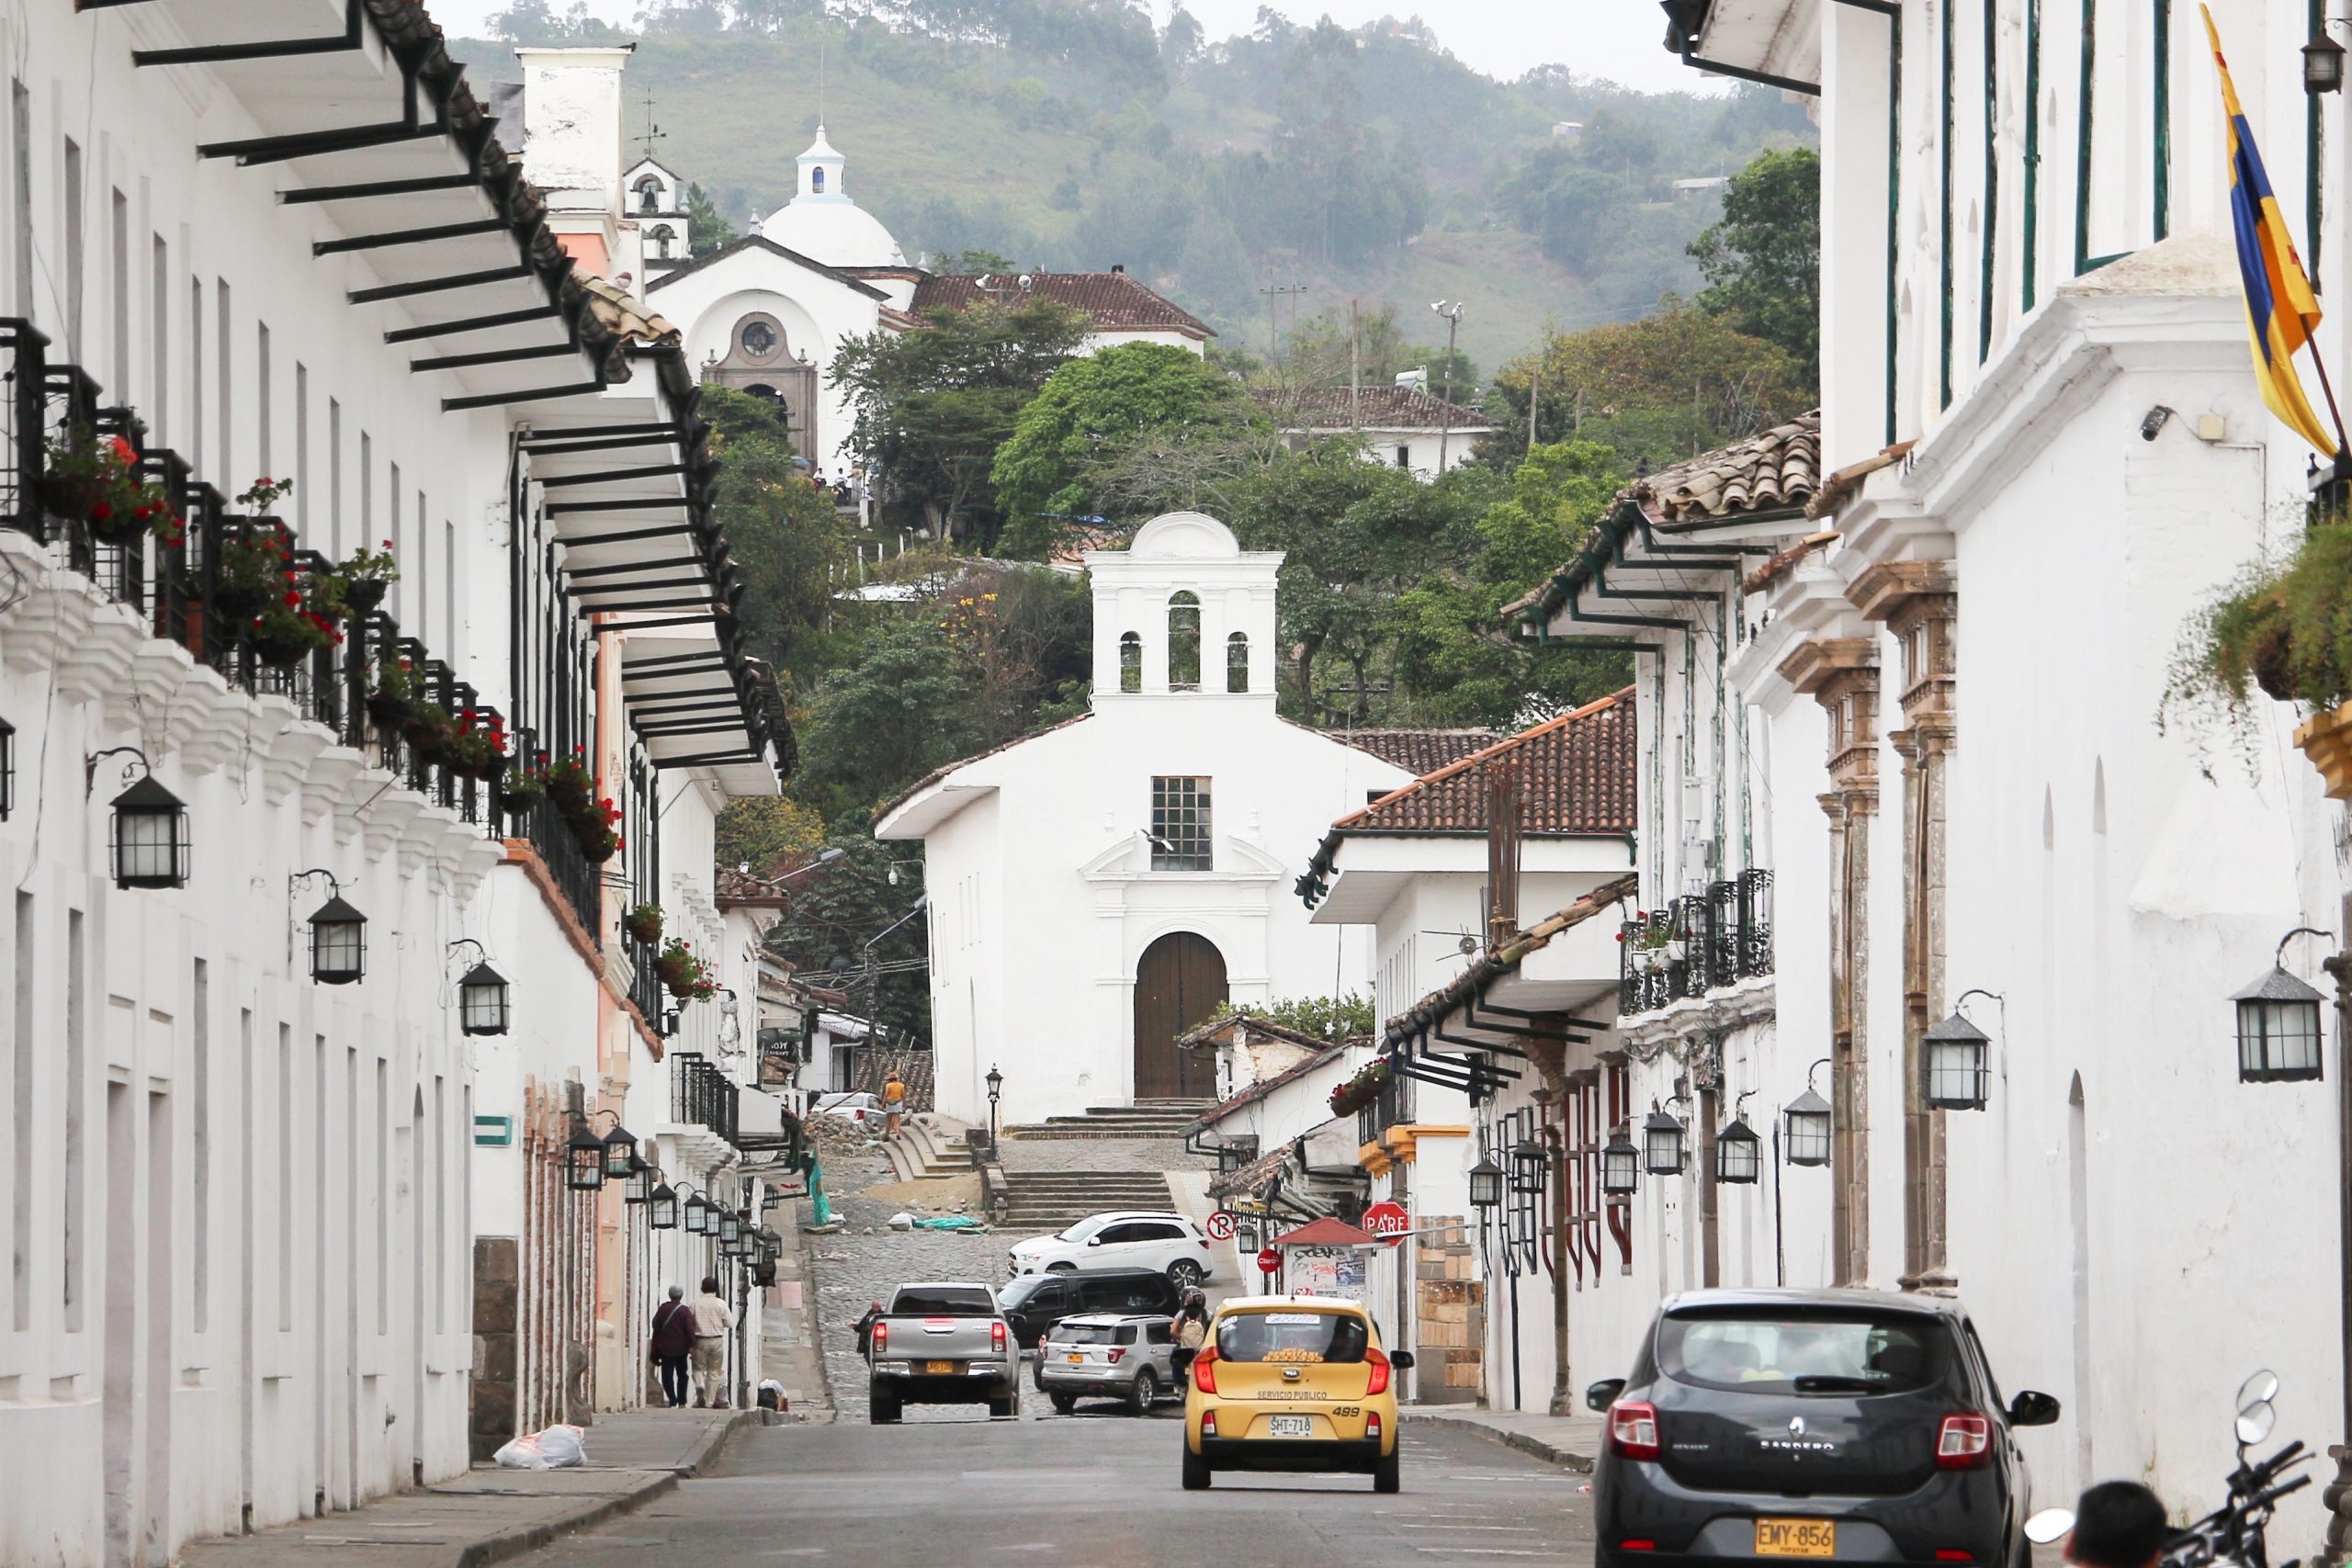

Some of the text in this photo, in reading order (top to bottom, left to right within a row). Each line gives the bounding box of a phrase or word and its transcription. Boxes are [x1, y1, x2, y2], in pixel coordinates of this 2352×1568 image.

[1366, 1215, 1405, 1233] PARE
[1258, 1257, 1276, 1265] Claro
[1257, 1391, 1328, 1400] SERVICIO PUBLICO
[1332, 1406, 1361, 1417] 499
[1271, 1418, 1311, 1432] SHT-718
[1760, 1439, 1835, 1451] SANDERO
[1758, 1524, 1832, 1548] EMY-856
